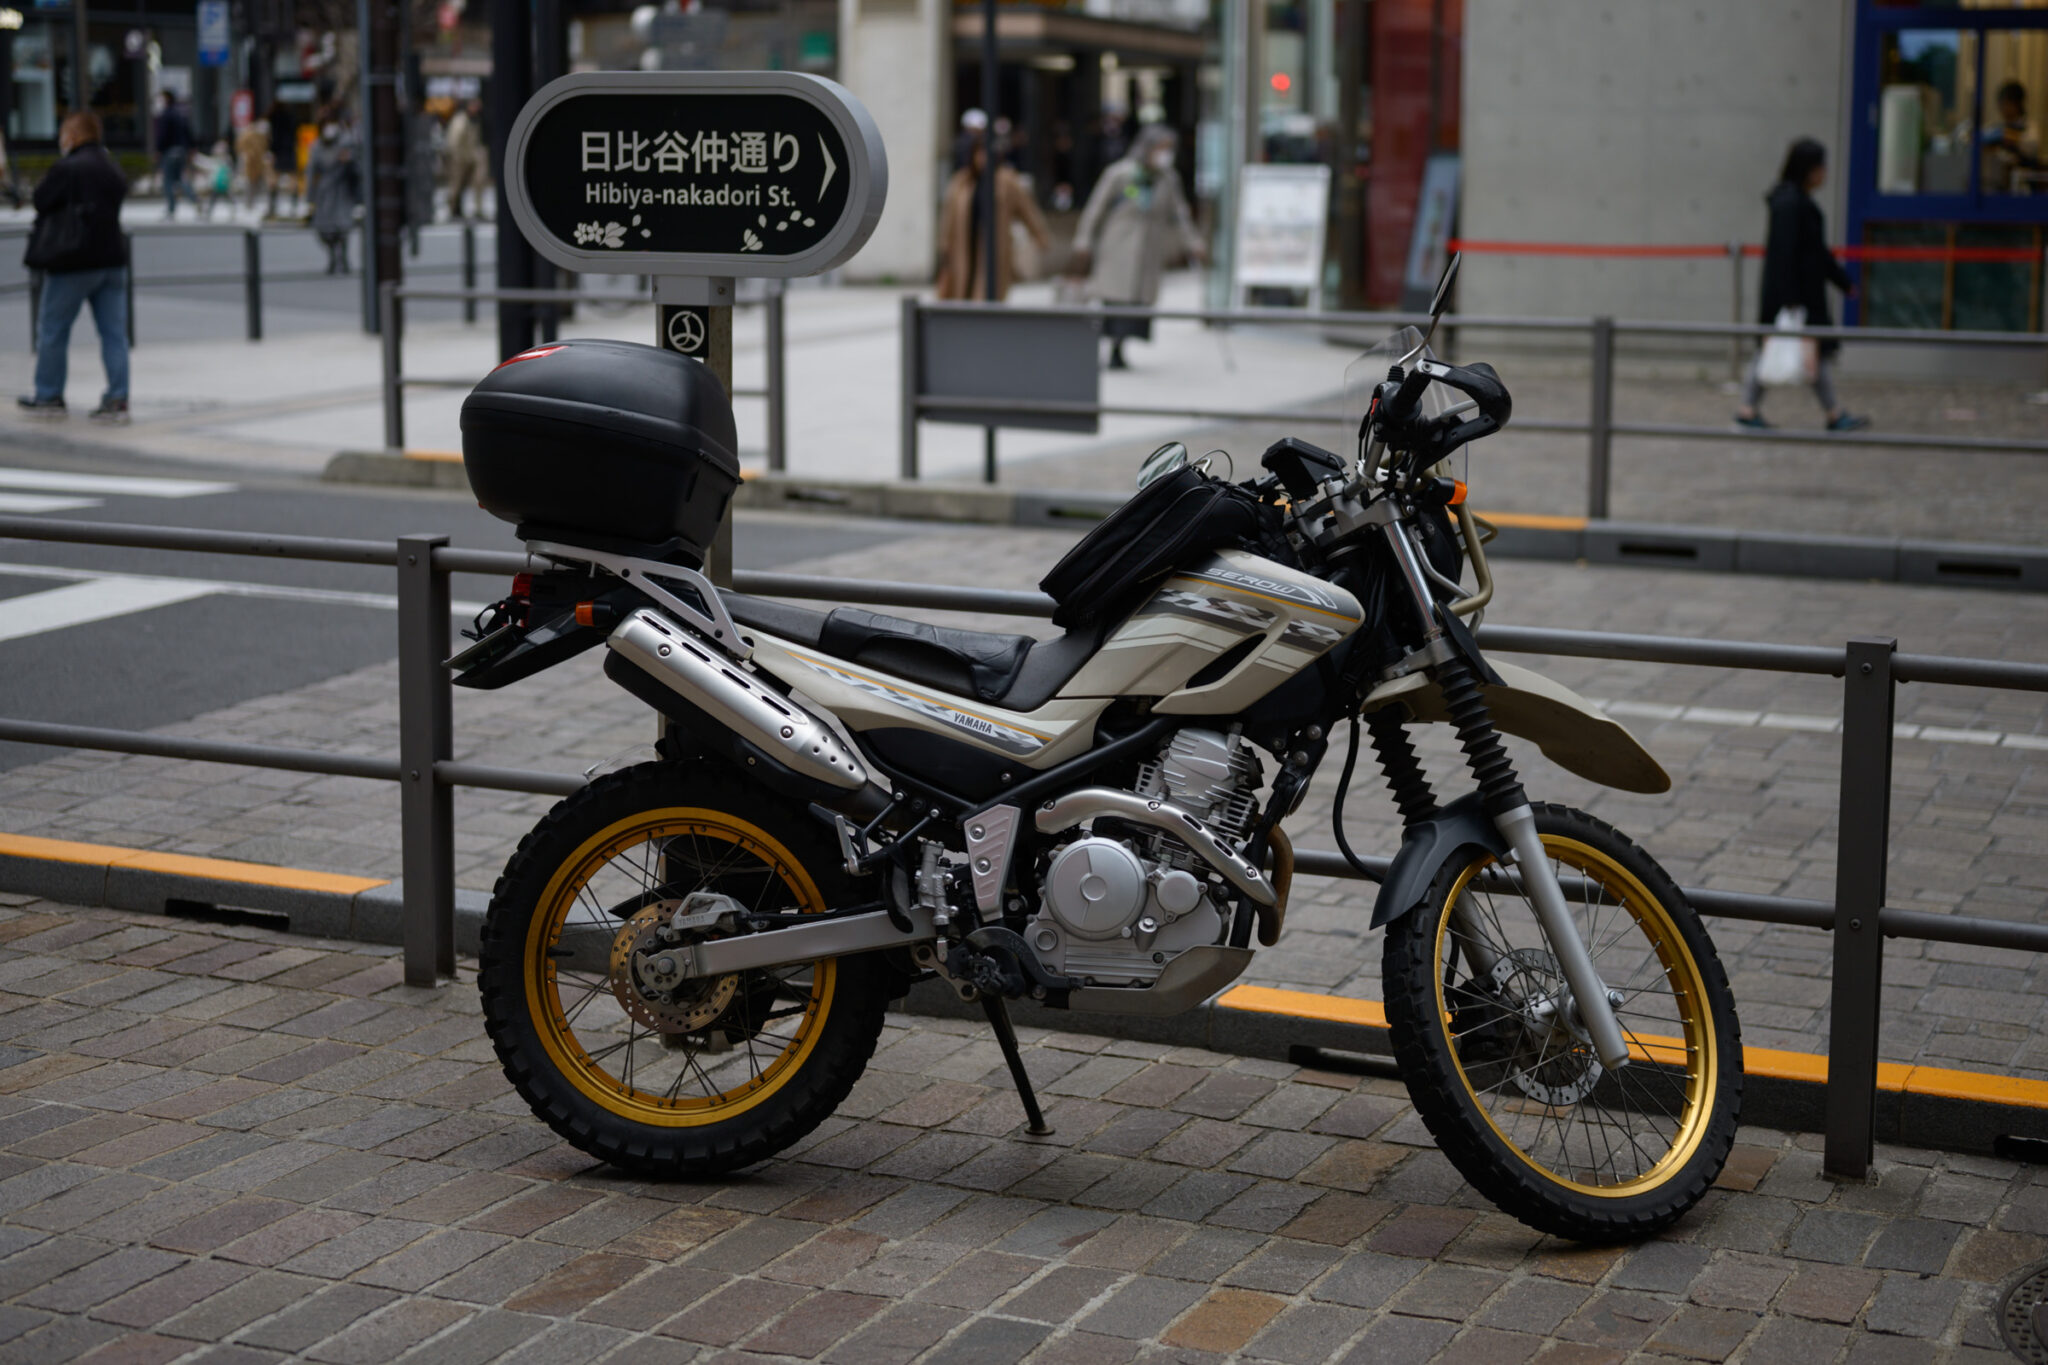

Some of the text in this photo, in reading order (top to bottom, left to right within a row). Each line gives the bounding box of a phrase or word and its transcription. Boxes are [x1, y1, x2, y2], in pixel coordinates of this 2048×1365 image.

[580, 130, 800, 174] 日比谷仲通り
[585, 182, 797, 210] Hibiya-nakadori St.
[1205, 568, 1297, 594] SEROW
[954, 713, 993, 734] YAMAHA
